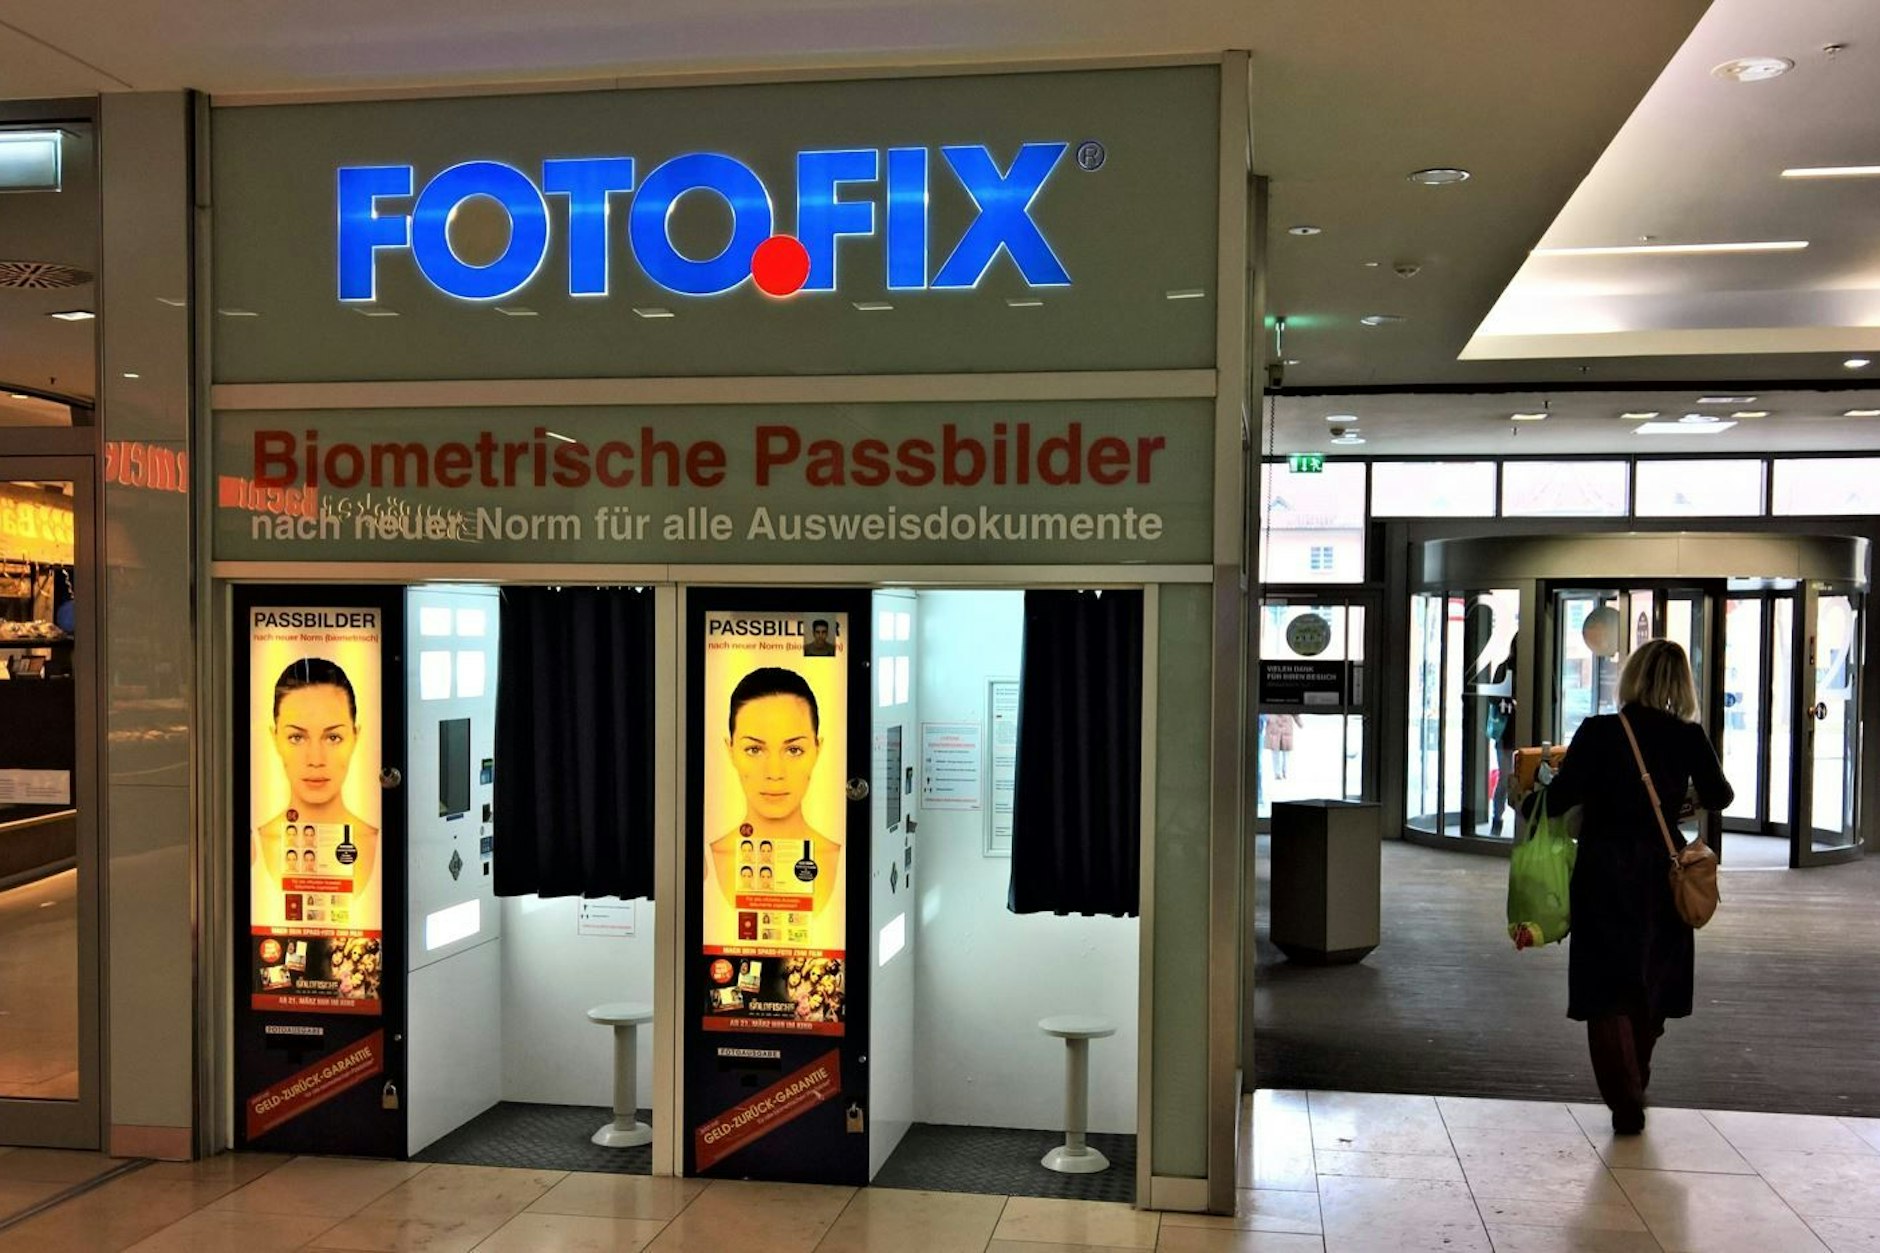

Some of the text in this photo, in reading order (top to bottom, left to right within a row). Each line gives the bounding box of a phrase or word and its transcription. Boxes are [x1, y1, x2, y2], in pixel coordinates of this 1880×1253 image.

[253, 426, 727, 489] Biometrische
[755, 422, 1165, 488] Passbilder
[251, 506, 340, 541] nach
[355, 513, 461, 541] neuer
[477, 507, 585, 541] Norm
[595, 506, 651, 541] für
[663, 506, 733, 541] alle
[746, 506, 1163, 541] Ausweisdokumente
[254, 612, 376, 628] PASSBILDER
[760, 642, 784, 650] Norm
[703, 1067, 830, 1145] GELD-ZURÜCK-GARANTIE
